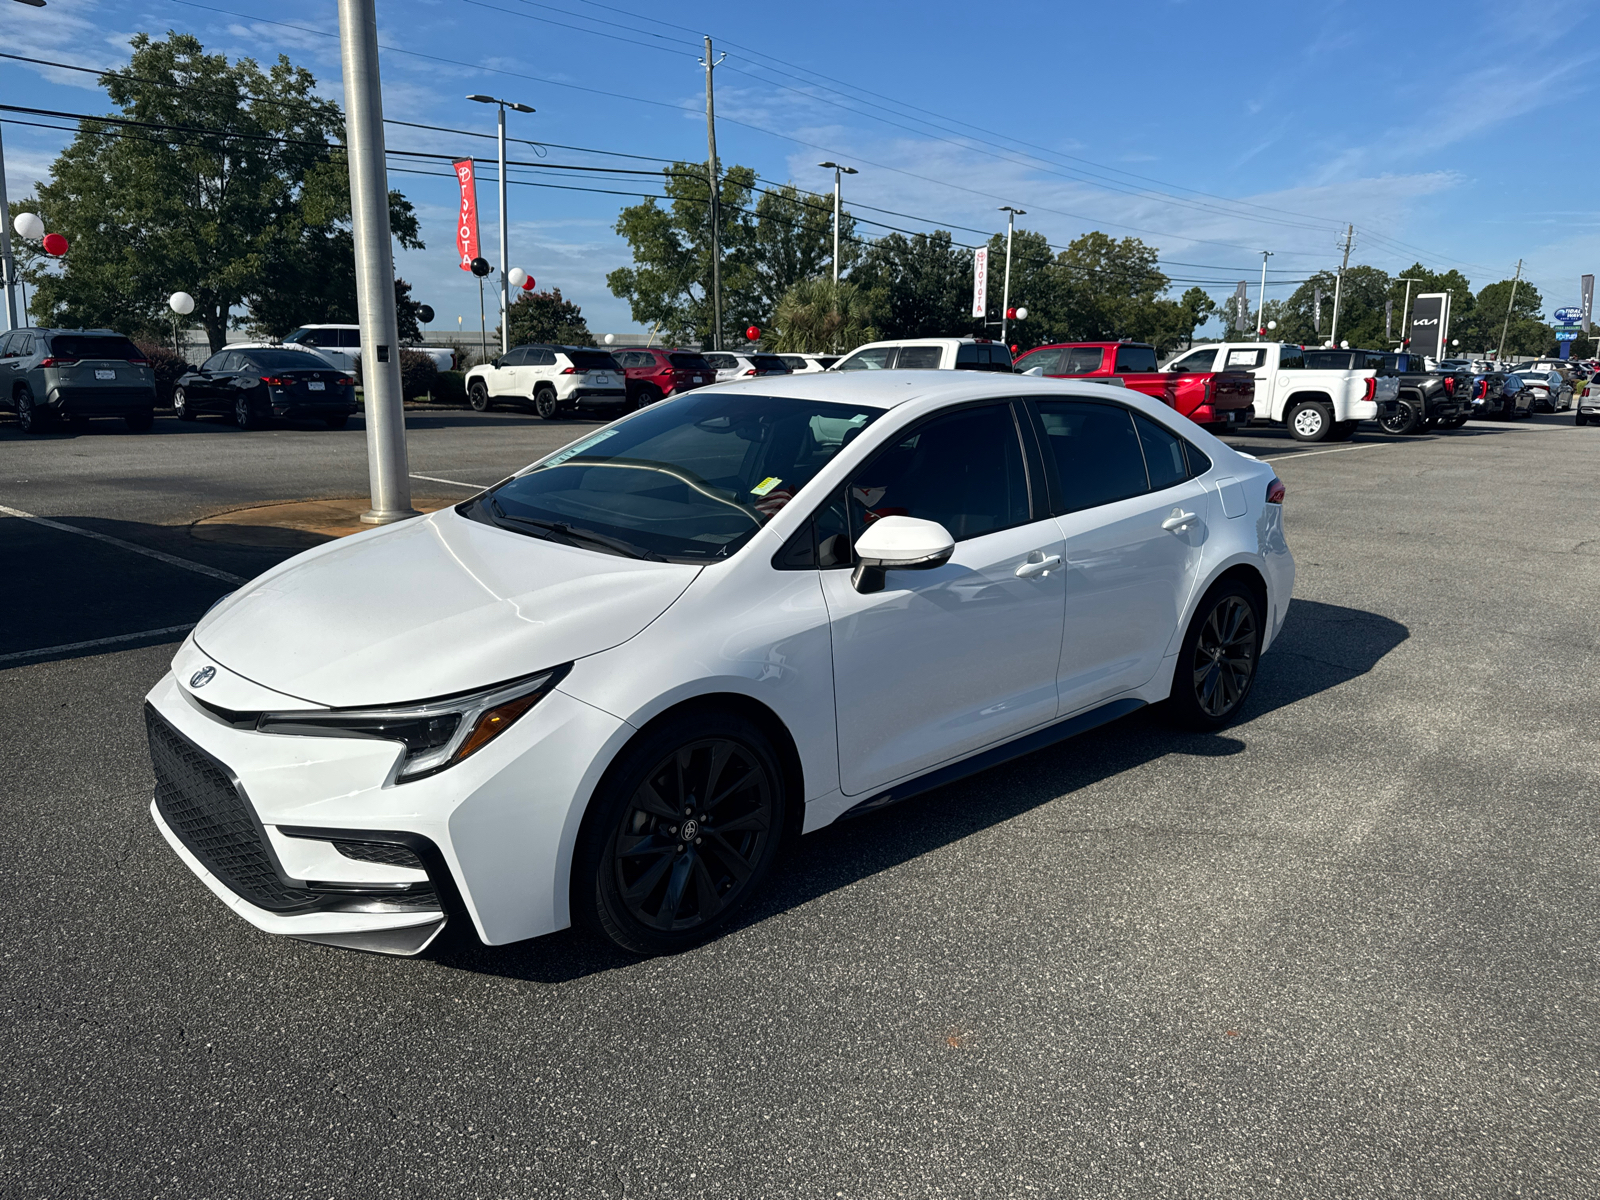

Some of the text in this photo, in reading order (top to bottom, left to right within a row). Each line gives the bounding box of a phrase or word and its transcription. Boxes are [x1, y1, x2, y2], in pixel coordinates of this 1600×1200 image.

[460, 185, 472, 265] TOYOTA
[976, 263, 984, 312] TOYOTA
[1413, 318, 1438, 326] KIA
